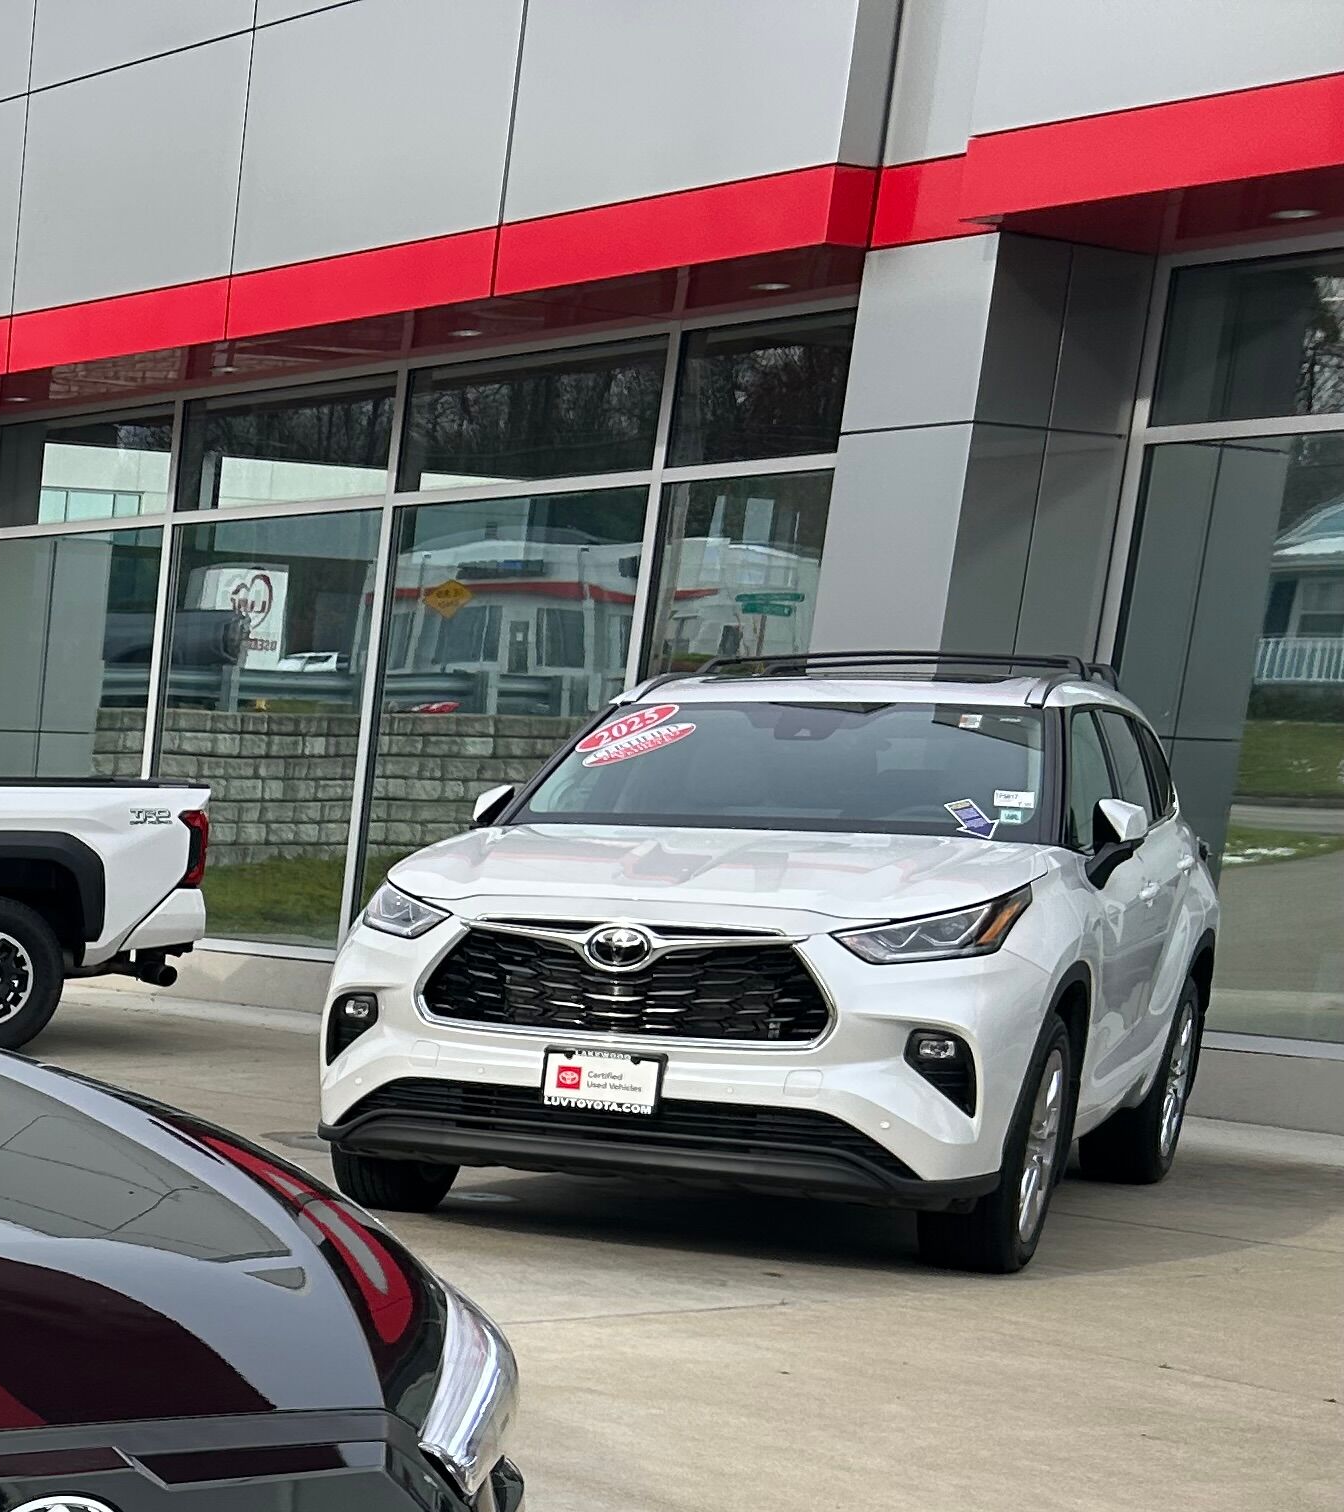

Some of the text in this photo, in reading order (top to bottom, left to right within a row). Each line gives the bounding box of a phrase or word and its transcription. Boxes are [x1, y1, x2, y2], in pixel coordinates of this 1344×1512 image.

[595, 709, 660, 745] 2025
[587, 1071, 624, 1081] Certified
[586, 1081, 642, 1093] Used Vehicles
[543, 1096, 652, 1115] LUVTOYOTA.COM
